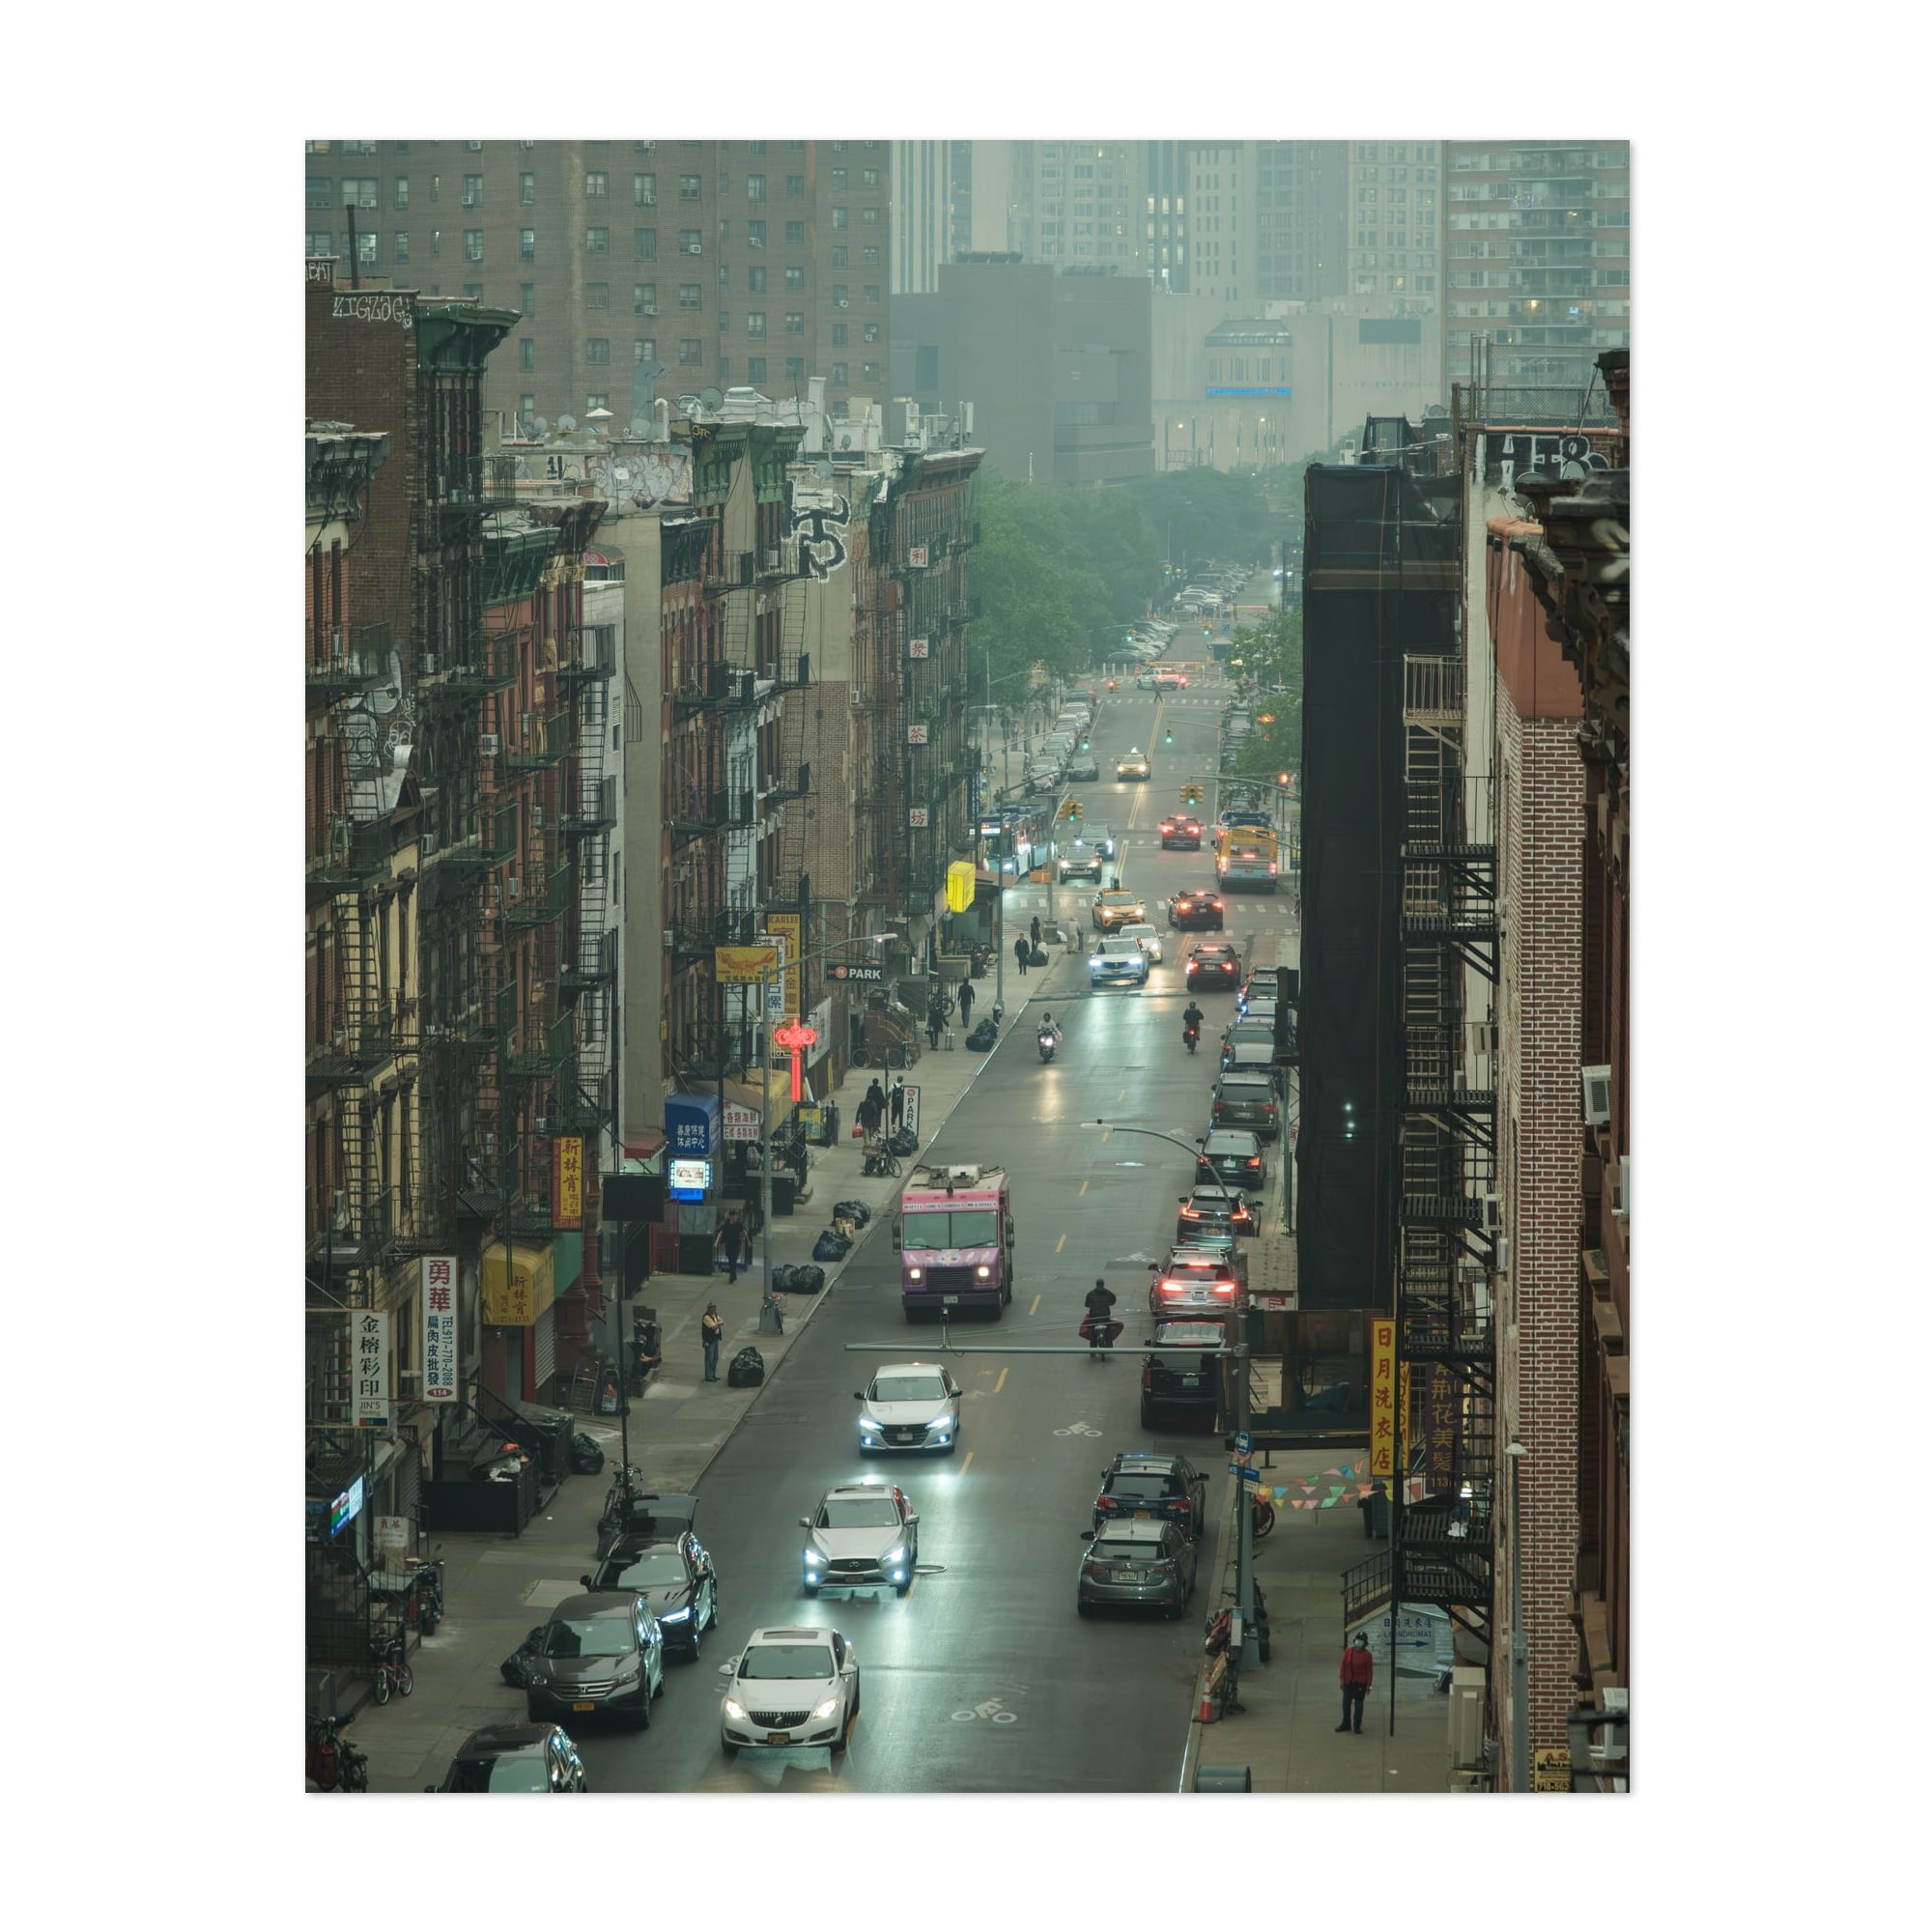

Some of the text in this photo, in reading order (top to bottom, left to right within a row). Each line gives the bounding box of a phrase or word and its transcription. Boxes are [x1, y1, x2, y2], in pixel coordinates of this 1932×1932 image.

[848, 969, 882, 980] PARK
[906, 1097, 915, 1128] PARK
[359, 1315, 380, 1397] 金榕彩印
[432, 1389, 448, 1398] 114
[1374, 1326, 1393, 1470] 日月洗衣店
[359, 1400, 381, 1409] JIN'S
[1383, 1630, 1432, 1638] LANDROMAT
